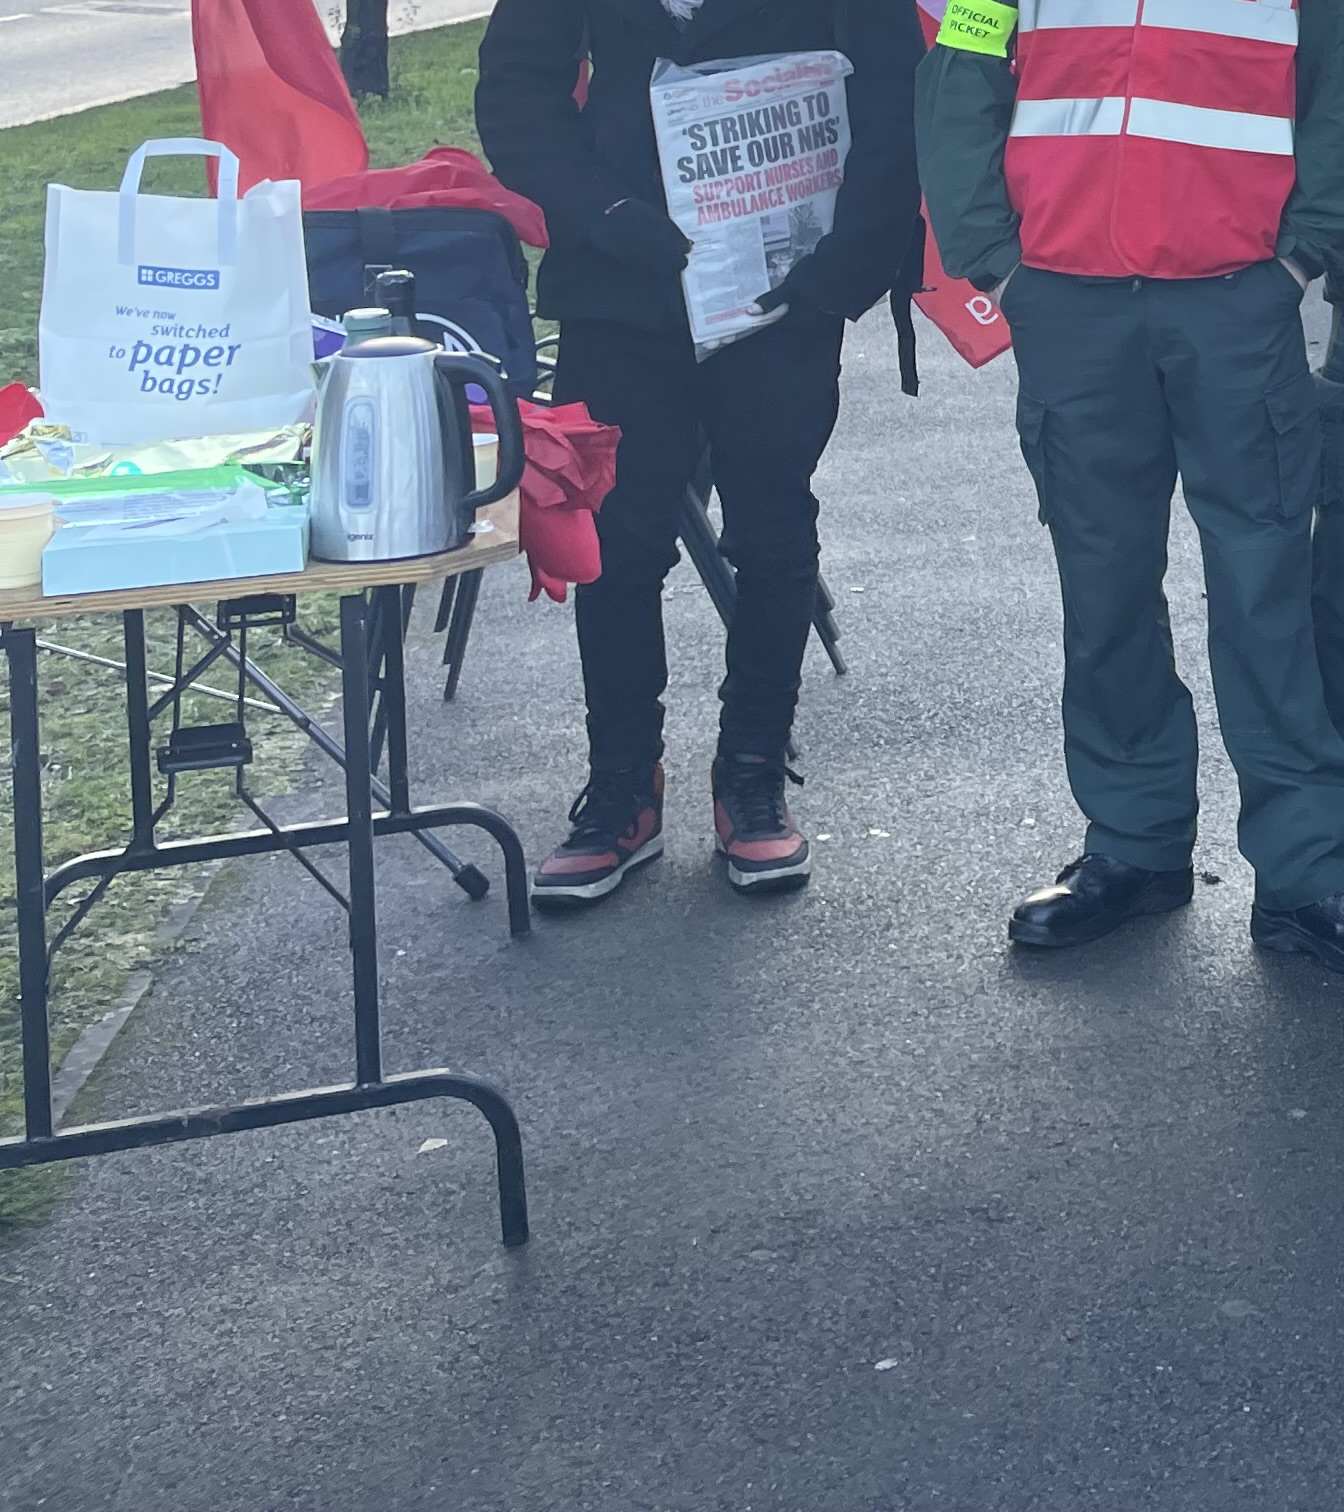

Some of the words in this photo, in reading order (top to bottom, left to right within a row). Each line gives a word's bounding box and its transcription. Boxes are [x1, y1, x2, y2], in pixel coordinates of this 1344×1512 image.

[949, 19, 991, 39] PICKET
[951, 4, 1000, 29] OFFICIAL
[803, 91, 830, 122] TO
[677, 145, 744, 184] SAVE
[747, 131, 795, 168] OUR
[693, 171, 762, 204] SUPPORT
[764, 159, 815, 187] NURSES
[815, 148, 839, 170] AND
[697, 189, 785, 226] AMBULANCE
[787, 169, 843, 202] WORKERS
[155, 270, 215, 287] GREGGS
[152, 310, 176, 320] now
[151, 323, 231, 339] switched
[109, 344, 126, 359] to
[128, 339, 241, 375] paper
[140, 370, 222, 401] bags!
